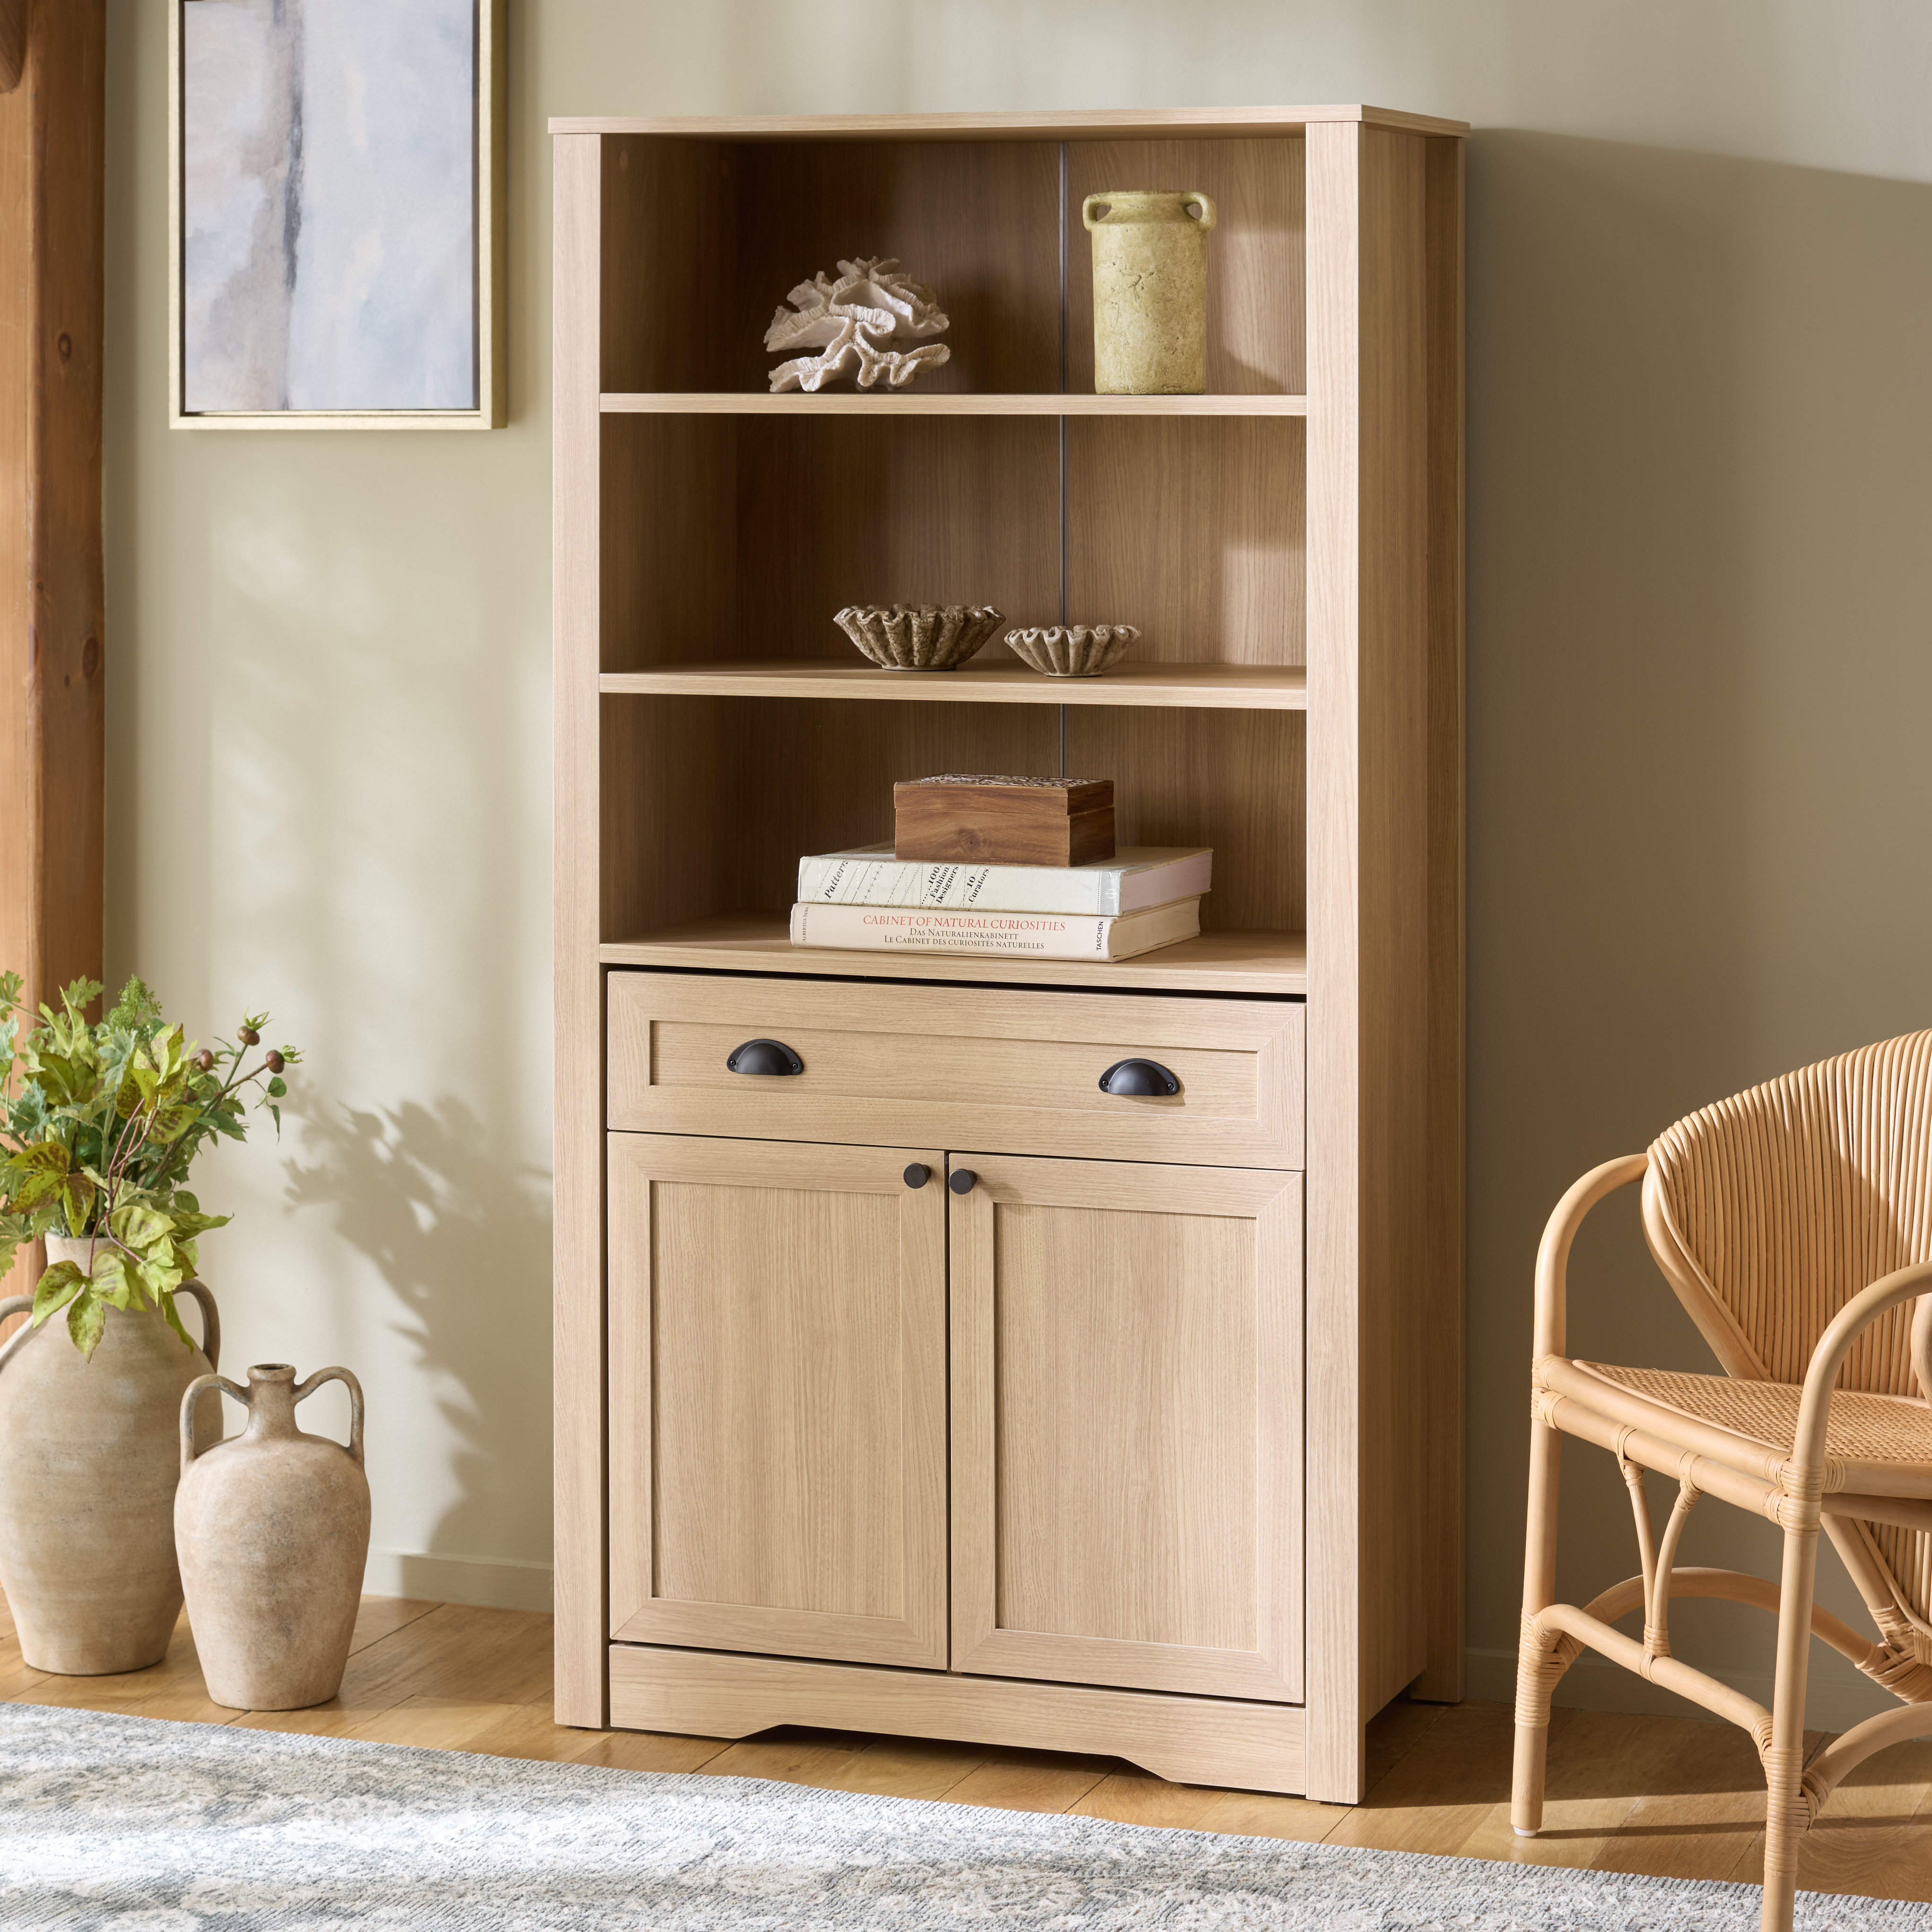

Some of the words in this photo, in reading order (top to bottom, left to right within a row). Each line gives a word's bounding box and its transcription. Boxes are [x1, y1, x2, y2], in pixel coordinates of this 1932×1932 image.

[928, 867, 940, 884] 100
[930, 867, 949, 898] Fashion
[967, 876, 975, 888] 10
[936, 866, 959, 904] Designers
[863, 915, 914, 925] CABINET
[916, 917, 931, 926] OF
[934, 918, 988, 928] NATURAL
[991, 919, 1066, 931] CURIOSITIES
